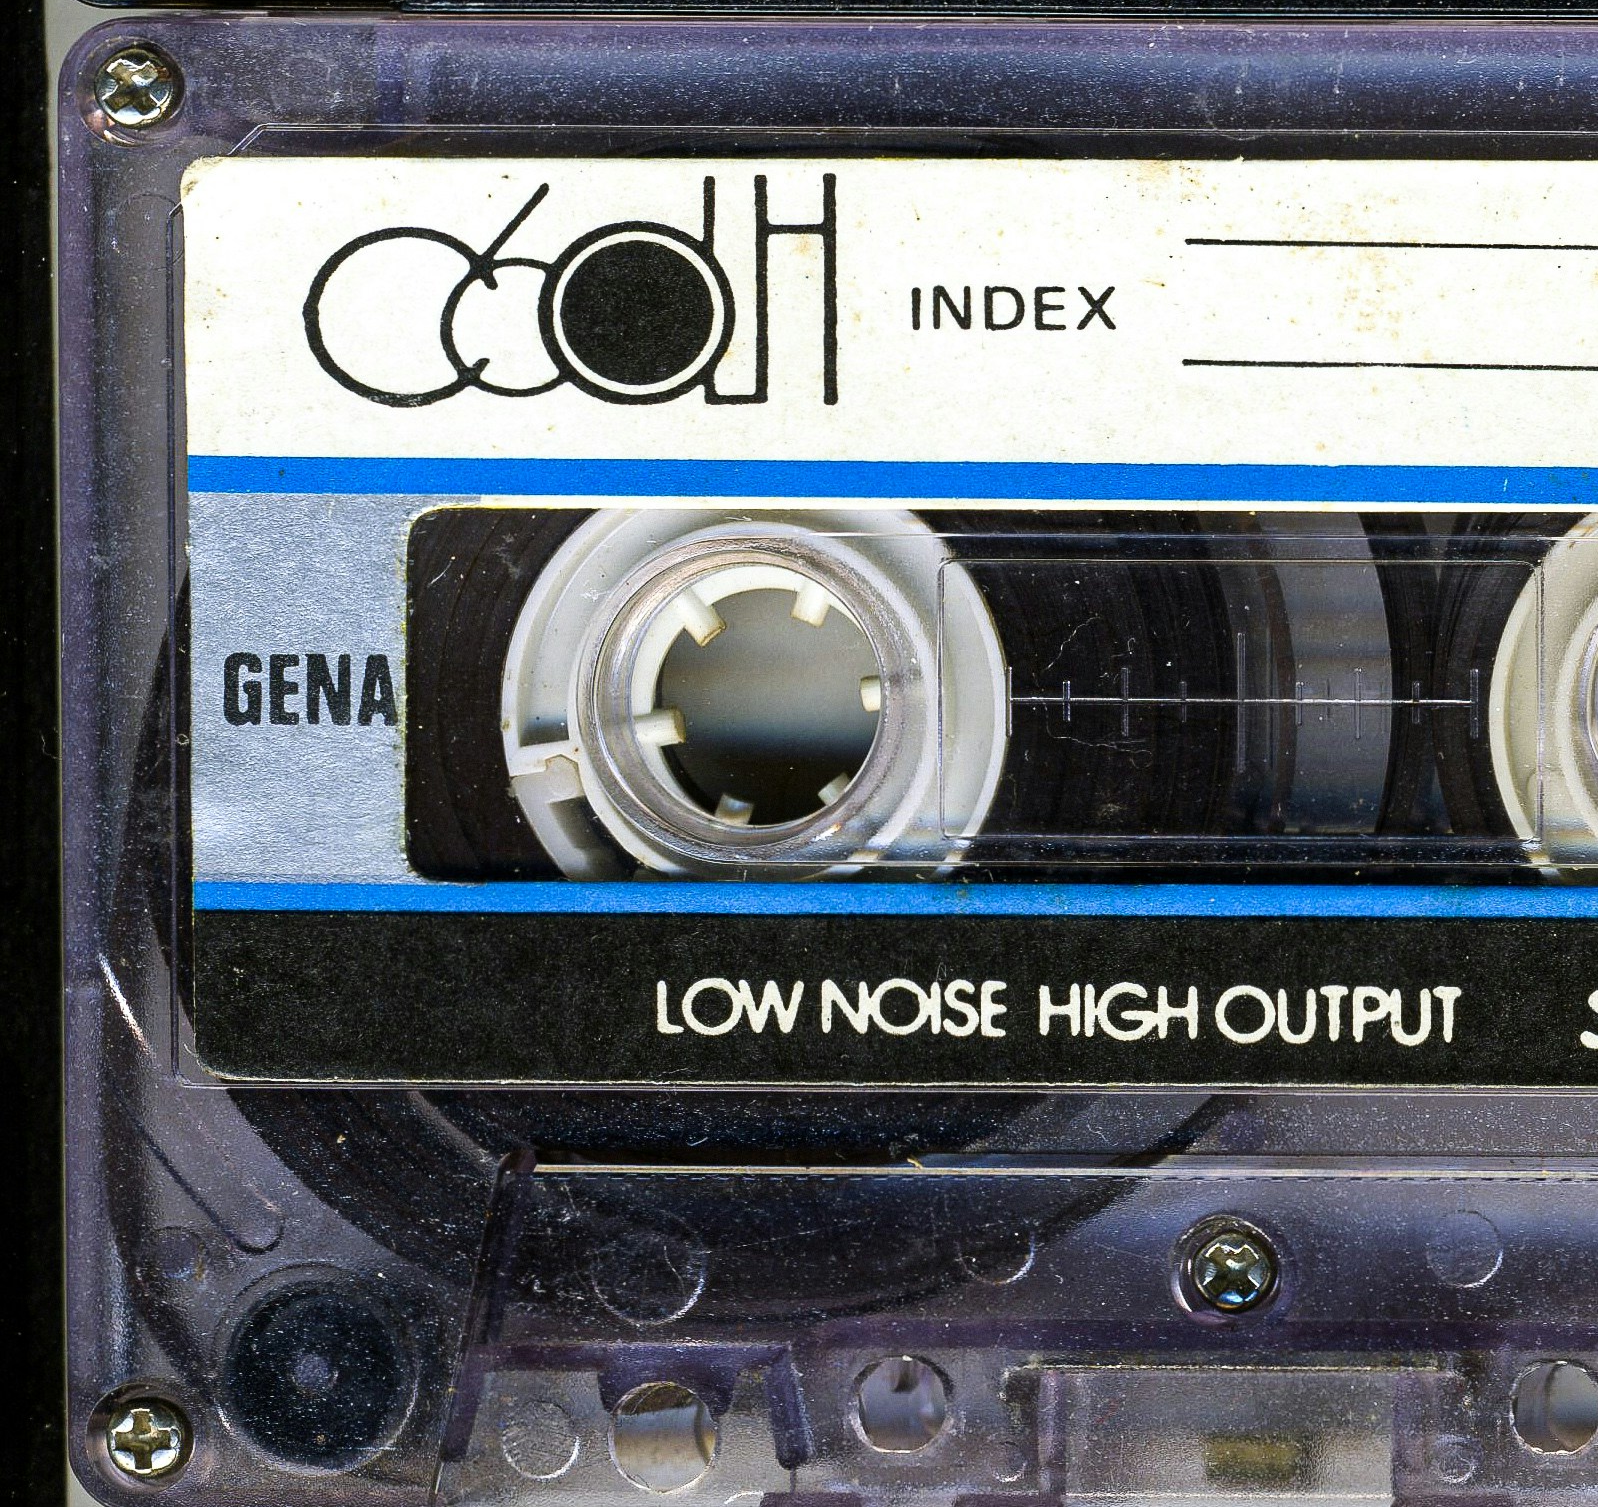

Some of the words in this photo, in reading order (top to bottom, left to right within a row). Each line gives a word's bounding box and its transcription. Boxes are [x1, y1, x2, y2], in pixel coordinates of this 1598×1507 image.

[909, 285, 1116, 332] INDEX
[223, 652, 398, 726] GENA
[657, 978, 805, 1035] LOW
[821, 978, 1006, 1036] NOISE
[1039, 983, 1199, 1039] HIGH
[1215, 983, 1462, 1045] OUTPUT
